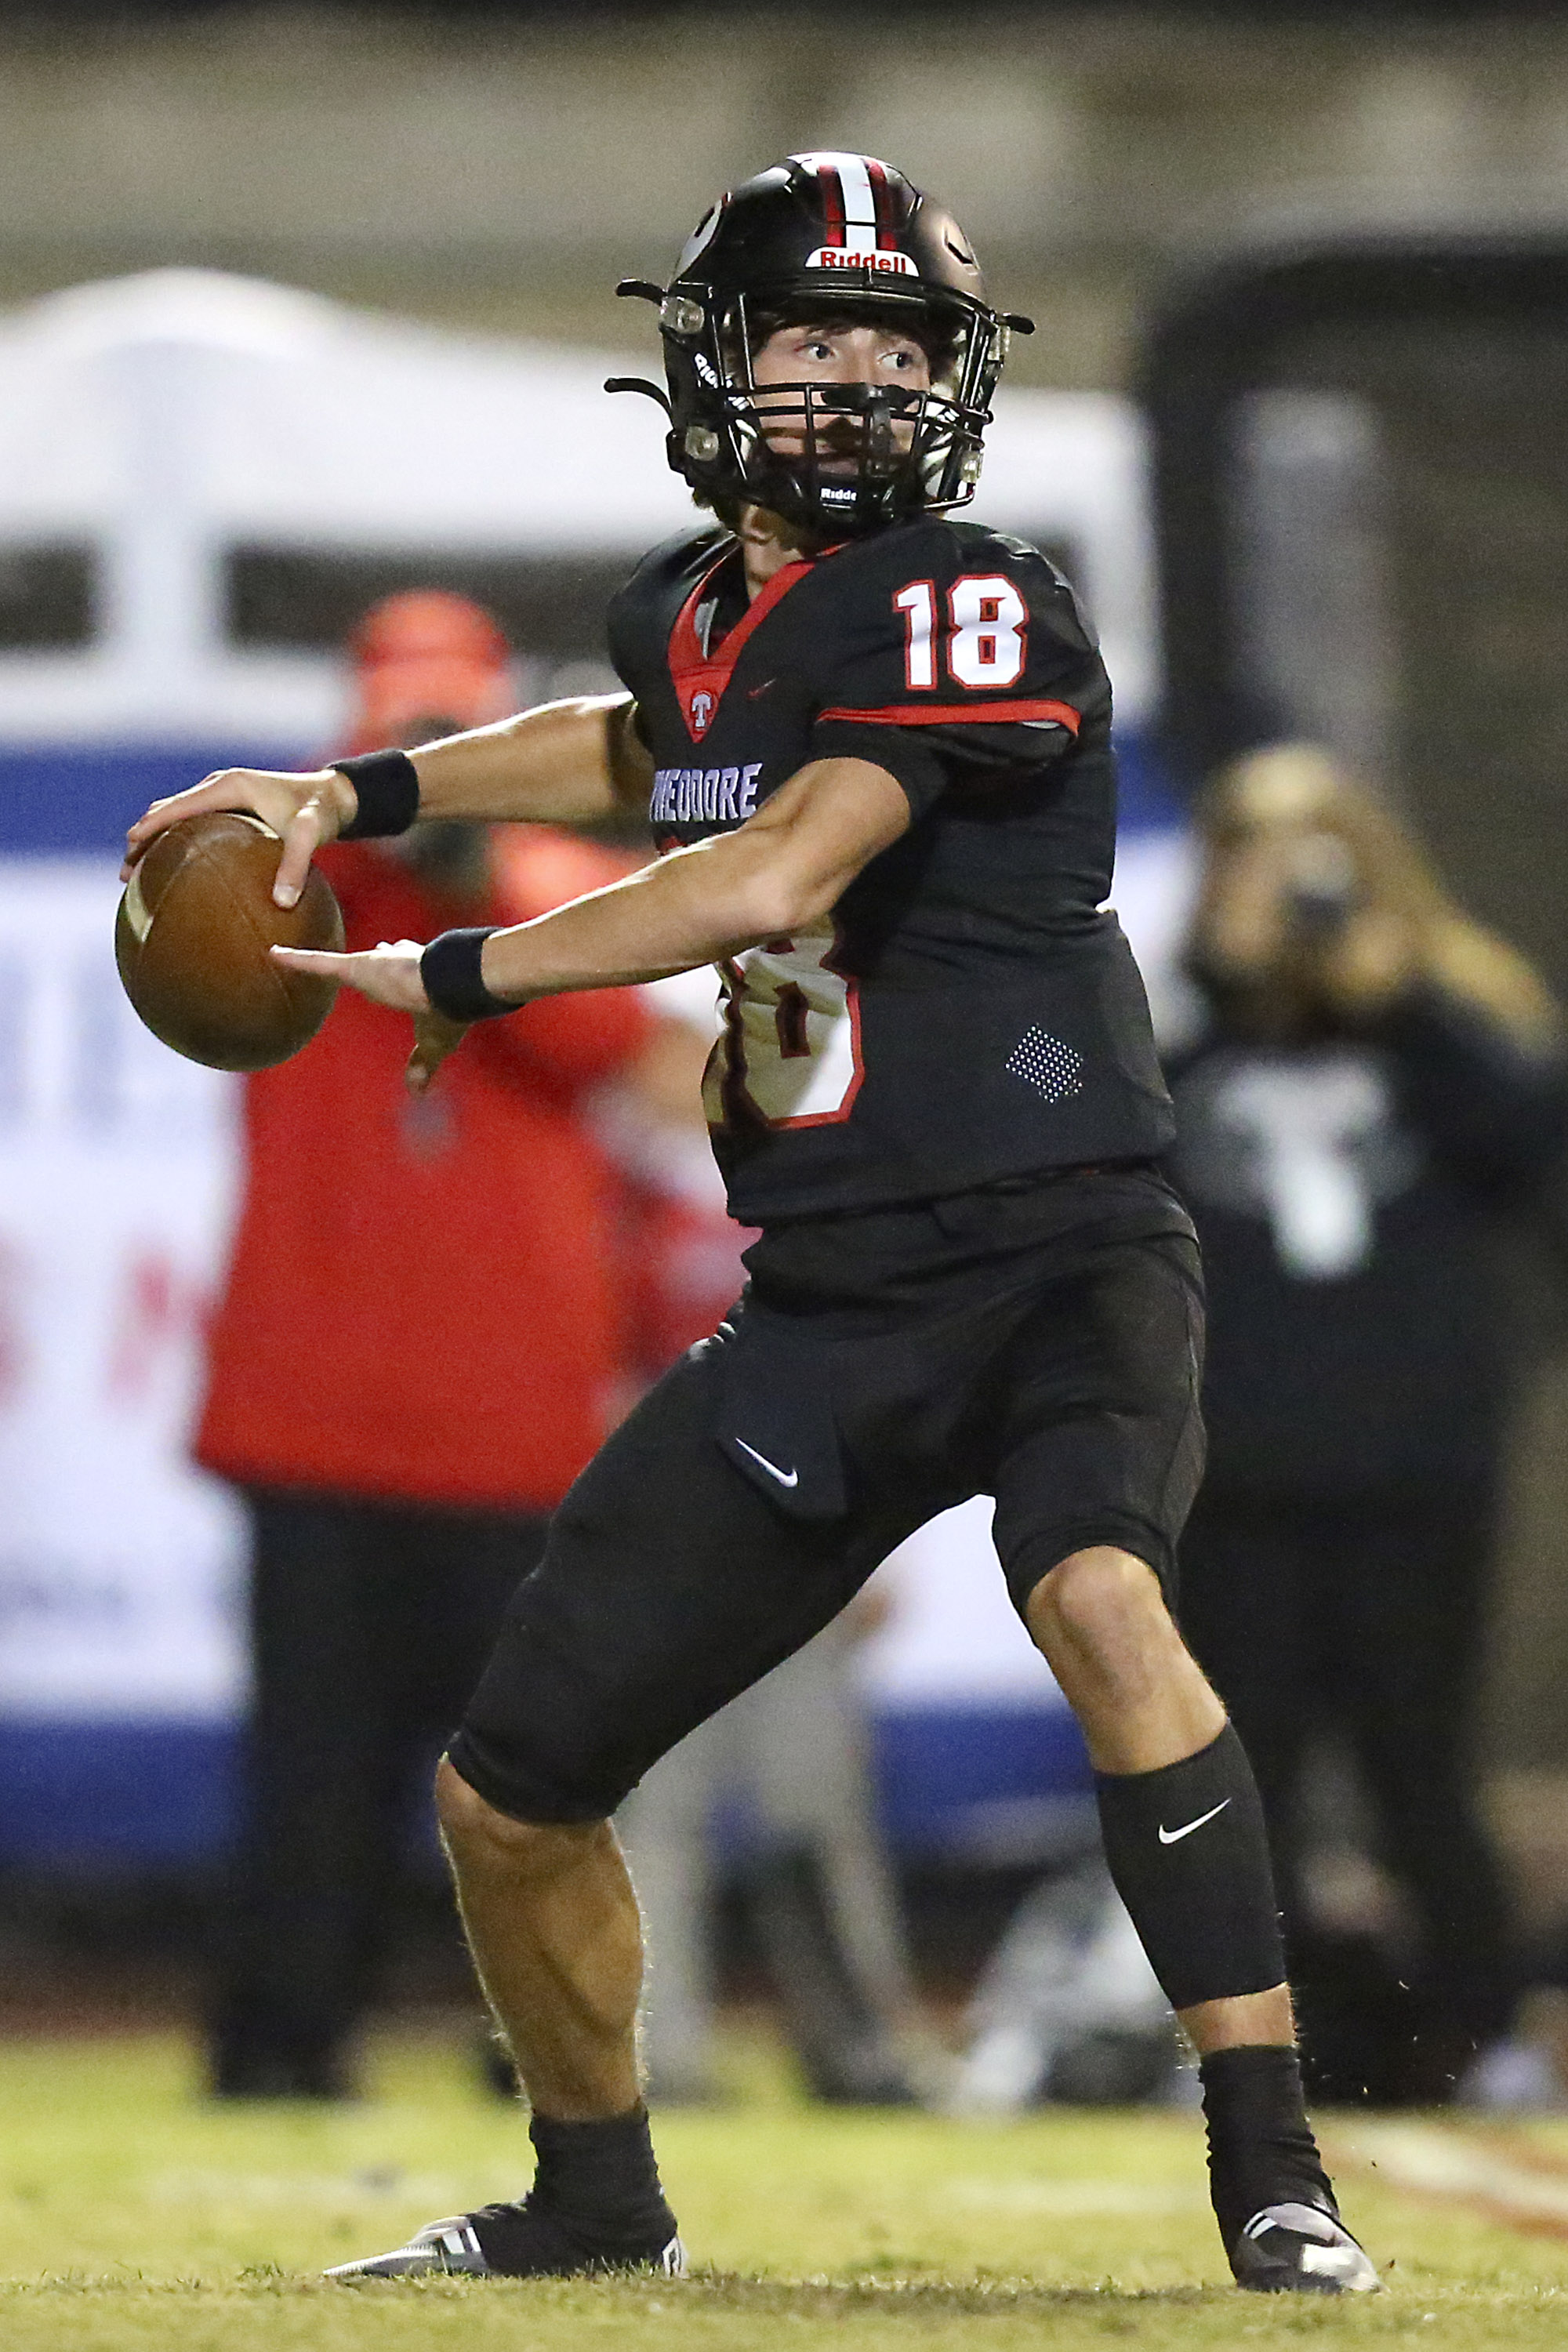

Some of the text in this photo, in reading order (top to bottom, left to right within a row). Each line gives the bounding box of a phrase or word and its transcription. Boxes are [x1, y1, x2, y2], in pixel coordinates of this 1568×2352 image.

[820, 251, 906, 274] Riddell
[892, 573, 1029, 690] 18
[691, 691, 712, 728] T
